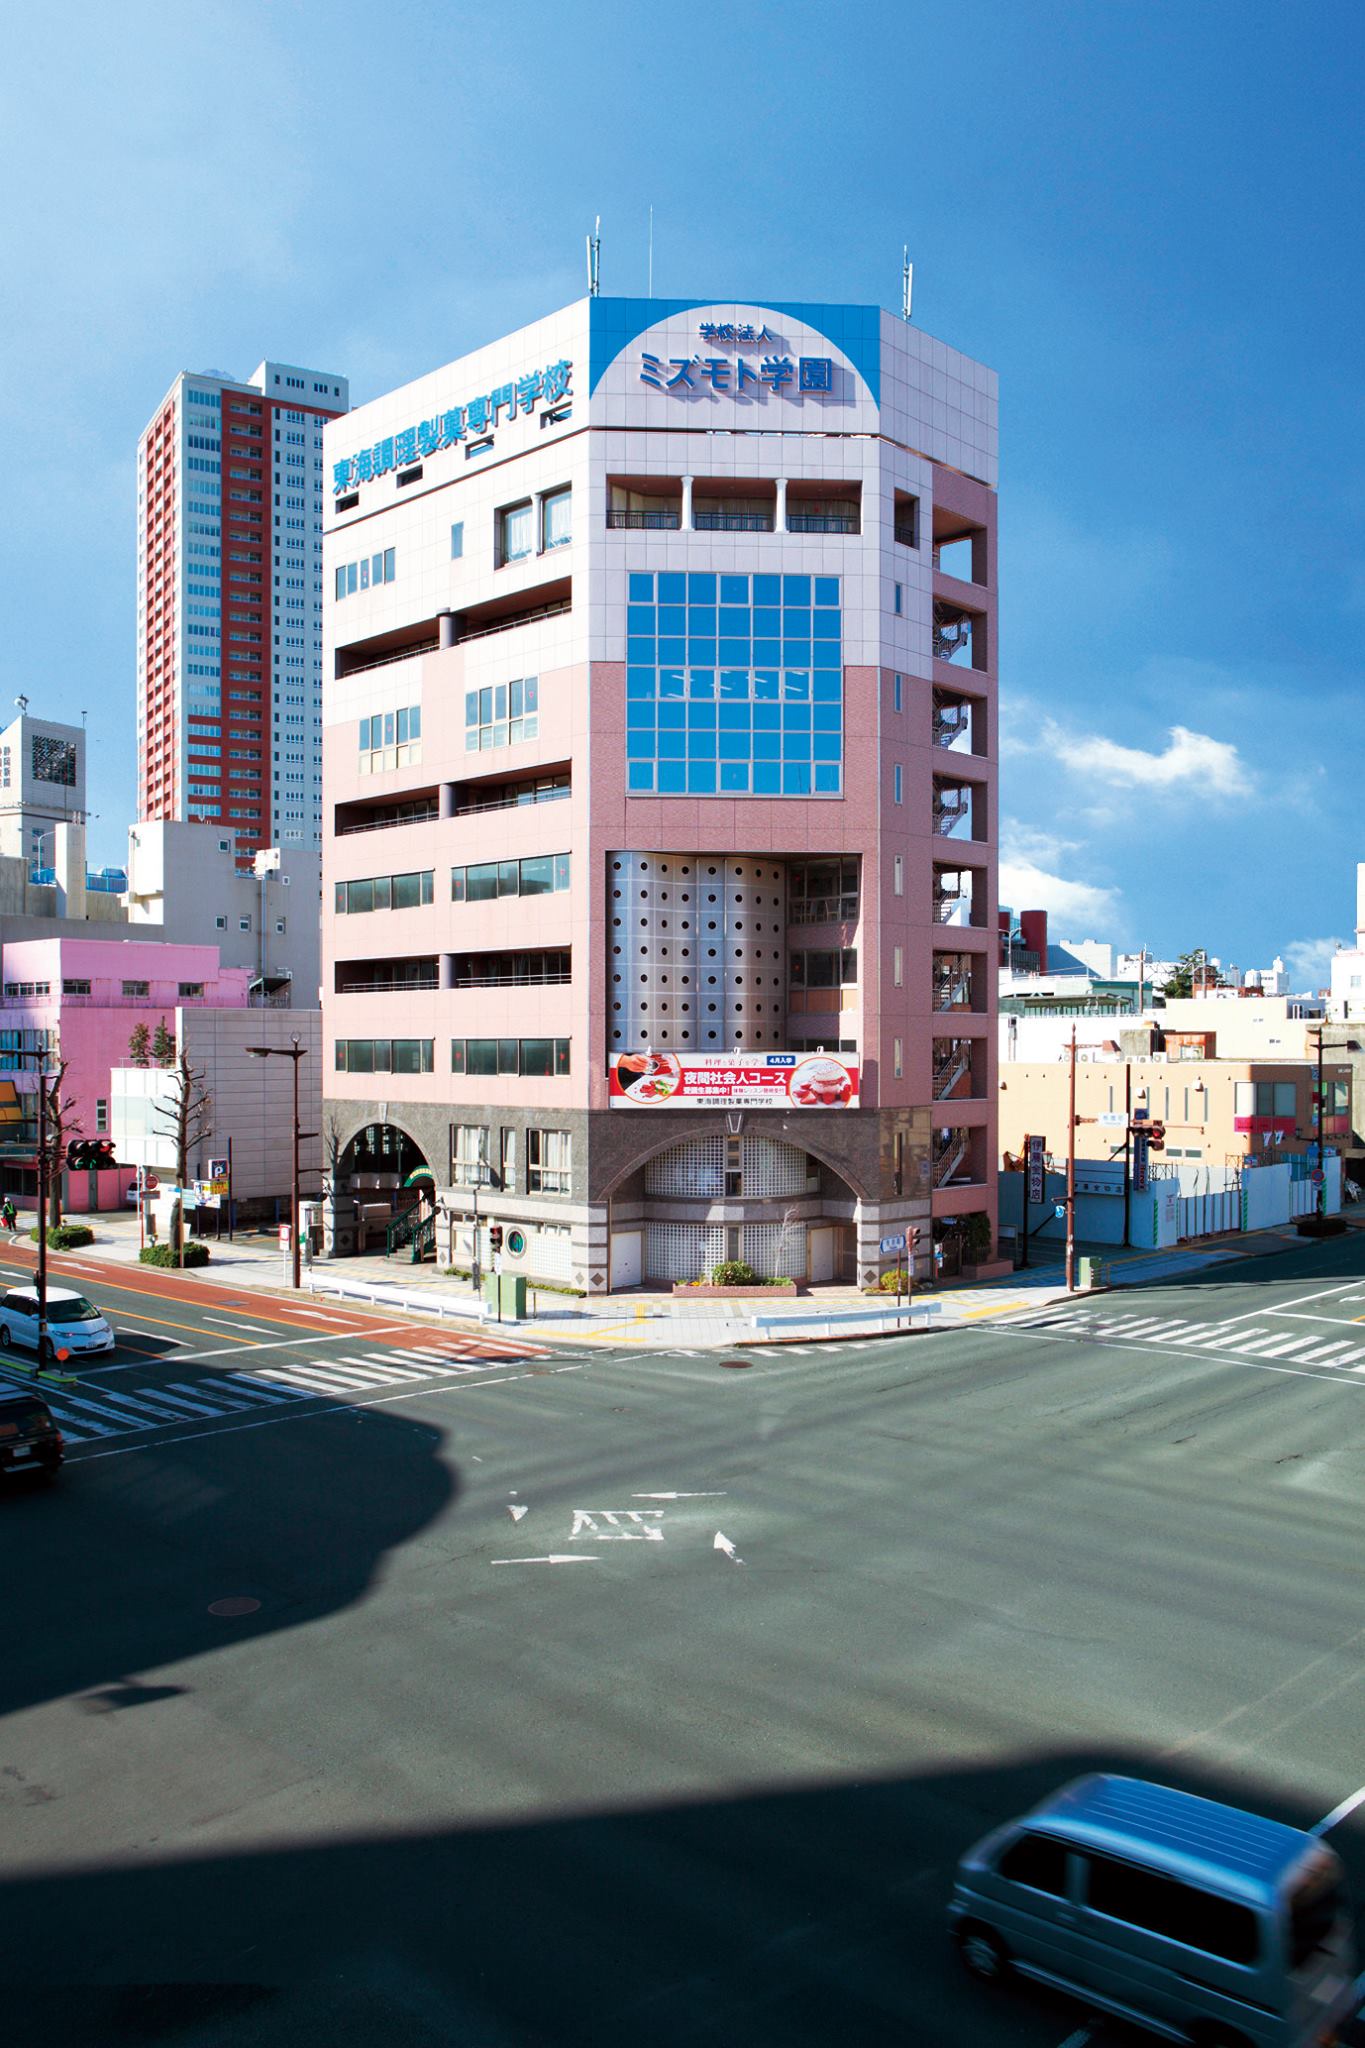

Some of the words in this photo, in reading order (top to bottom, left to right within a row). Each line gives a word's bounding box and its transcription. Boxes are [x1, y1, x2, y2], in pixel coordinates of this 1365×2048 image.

[699, 323, 773, 343] 学校法人
[640, 352, 833, 393] ミズモト学園
[332, 358, 574, 496] 東海調理製菓専門学校
[684, 1071, 787, 1085] 夜間社会人コース
